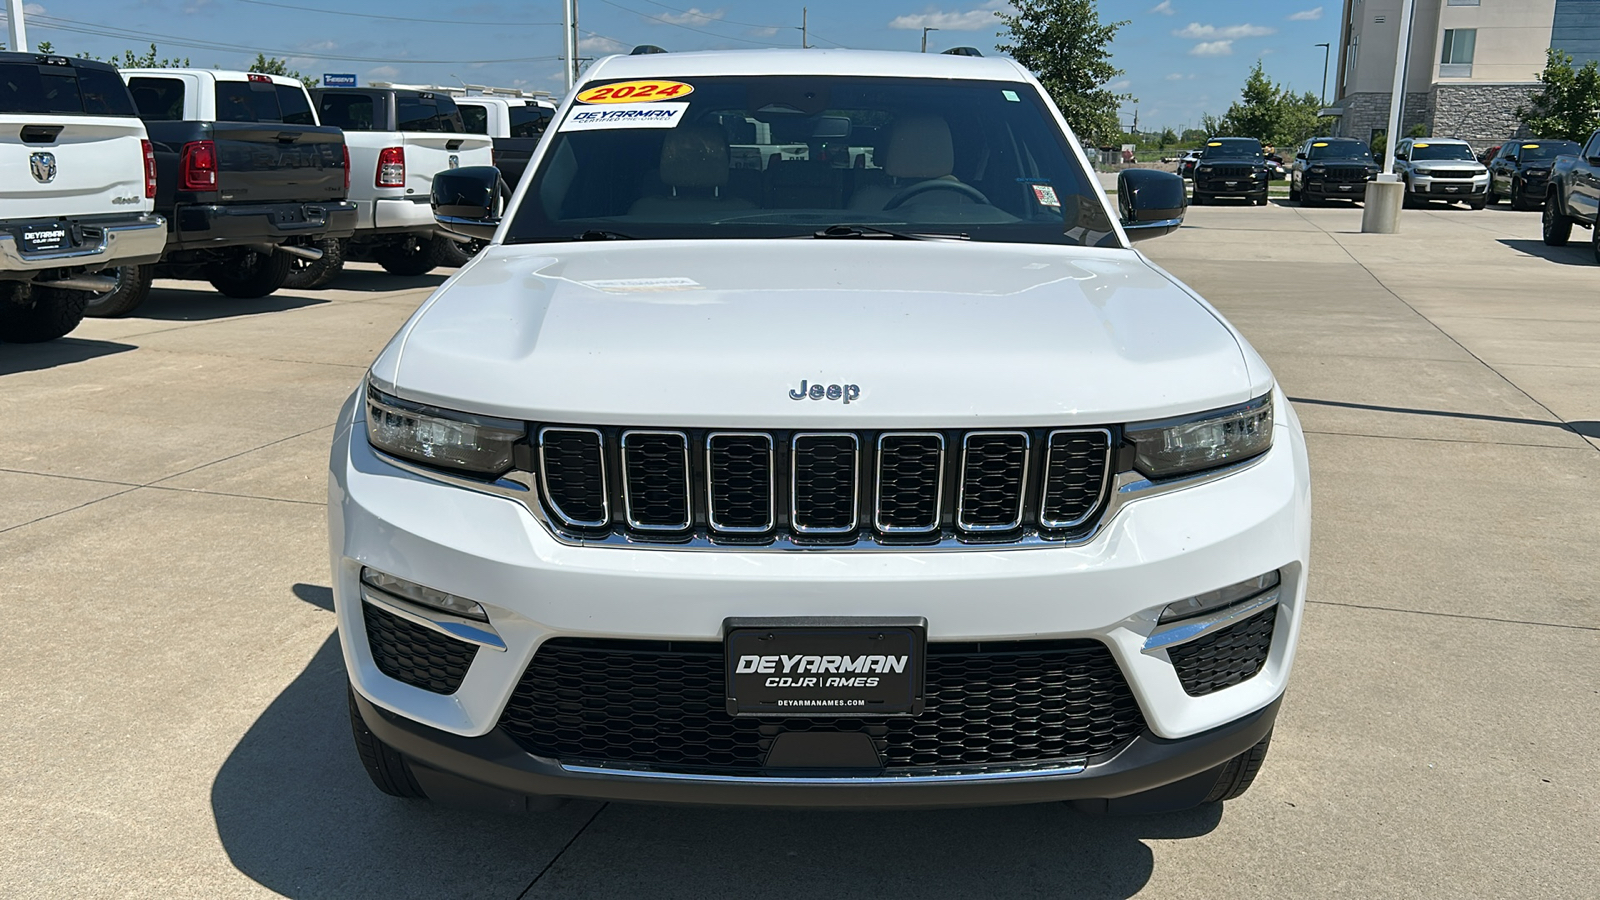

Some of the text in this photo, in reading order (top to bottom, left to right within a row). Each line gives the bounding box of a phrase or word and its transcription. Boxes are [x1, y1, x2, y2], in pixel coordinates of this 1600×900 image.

[586, 84, 683, 101] 2024
[573, 110, 678, 120] DEYARMAN
[24, 230, 65, 240] DEYARMAN
[789, 379, 860, 404] Jeep
[735, 654, 908, 674] DEYARMAN
[765, 677, 880, 687] CDJR AMES
